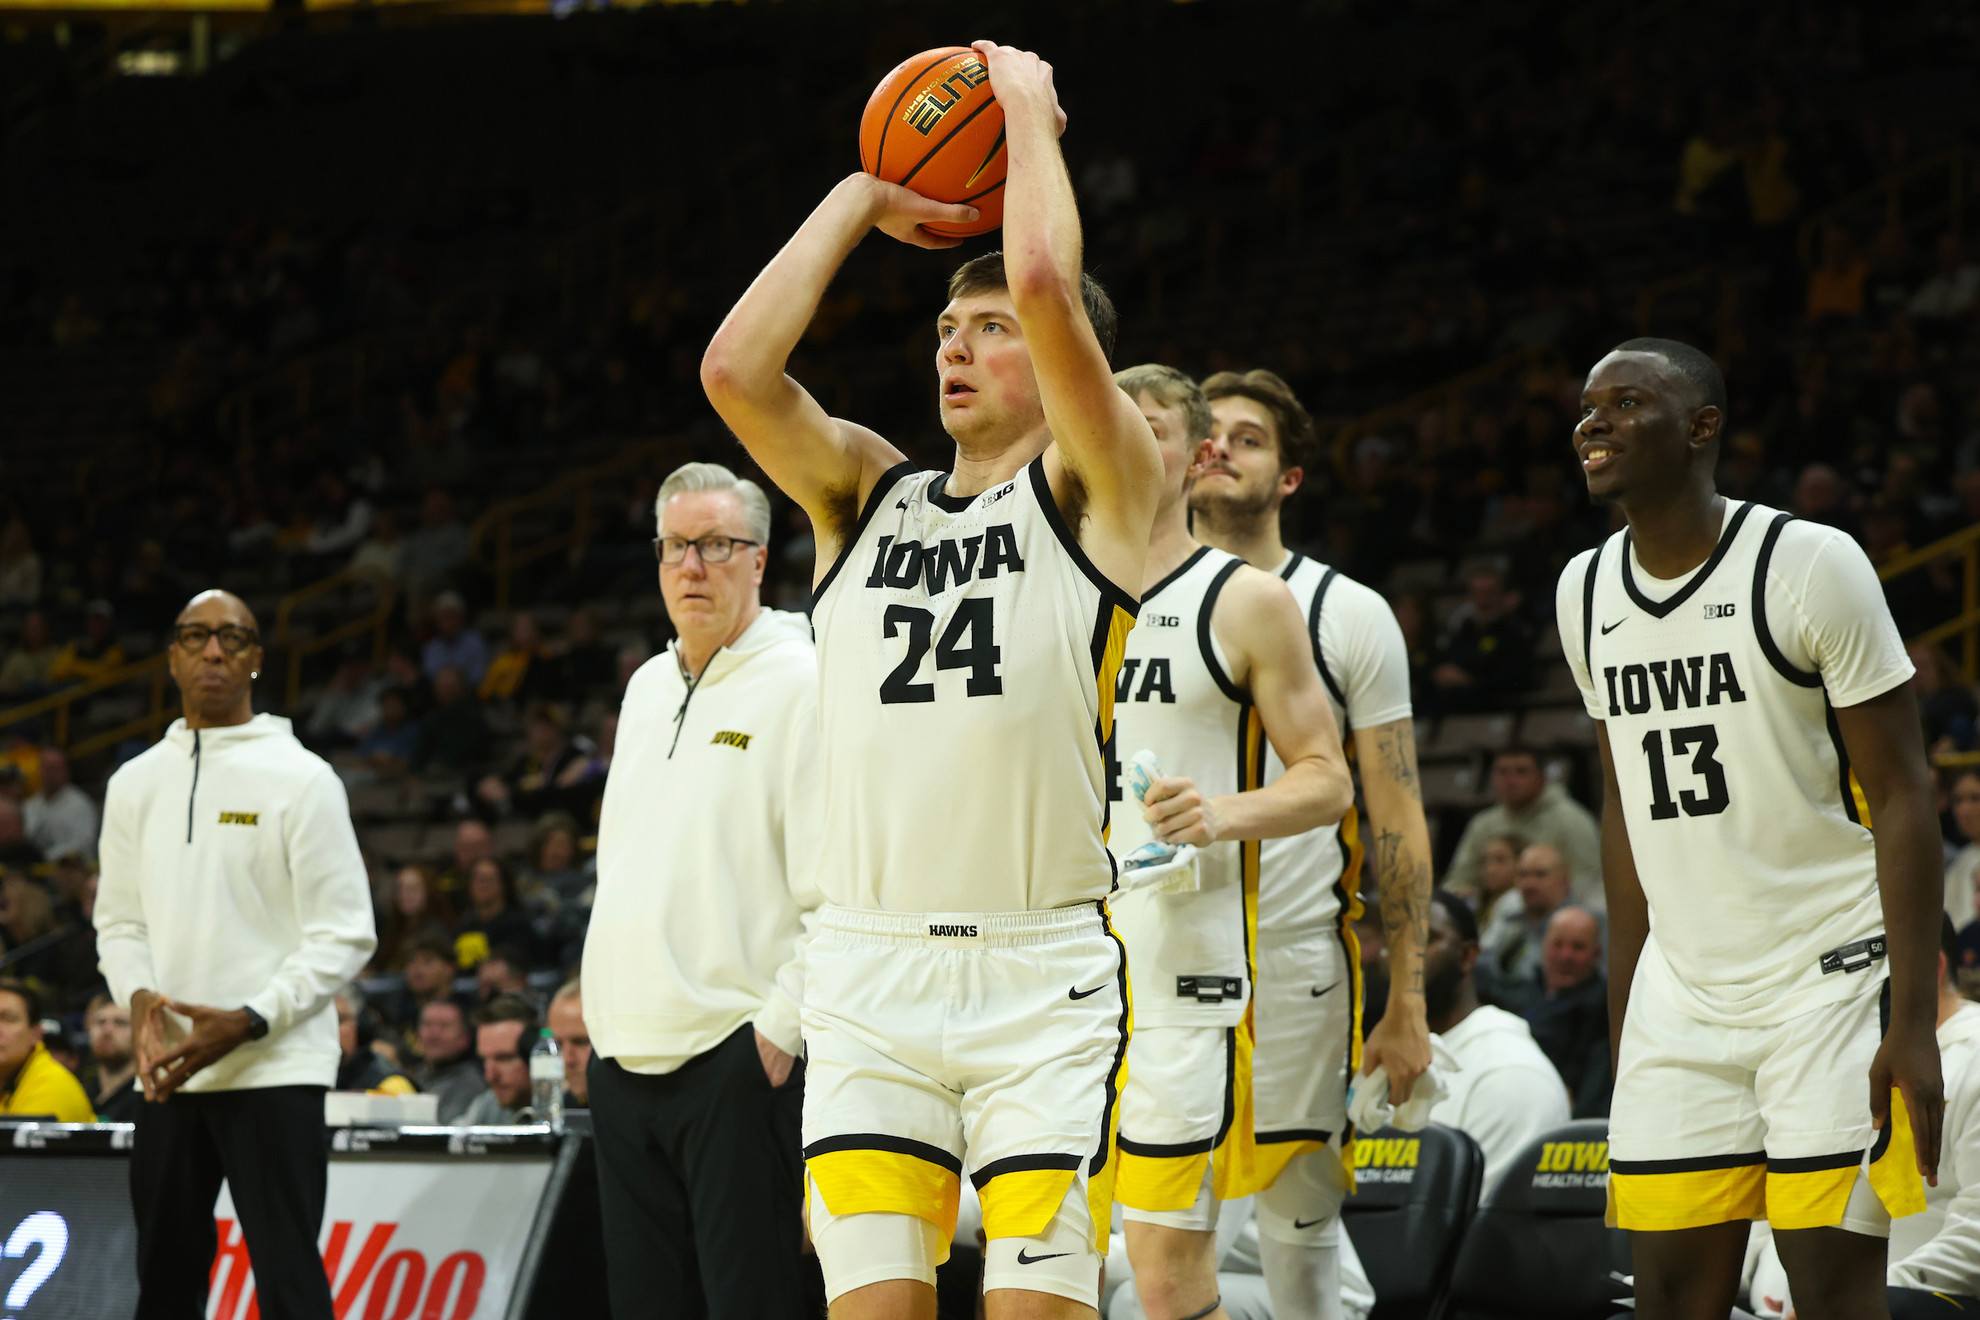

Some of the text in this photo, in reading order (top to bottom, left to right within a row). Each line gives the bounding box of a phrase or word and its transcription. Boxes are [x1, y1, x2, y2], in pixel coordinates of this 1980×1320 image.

[907, 60, 989, 137] ELITE
[865, 523, 1025, 597] IOWA
[879, 597, 1003, 704] 24
[1604, 652, 1747, 717] IOWA
[710, 730, 752, 750] IOWA
[1641, 724, 1730, 820] 13
[929, 924, 978, 938] HAWKS
[1870, 942, 1883, 953] 50
[1353, 1138, 1420, 1168] OWA
